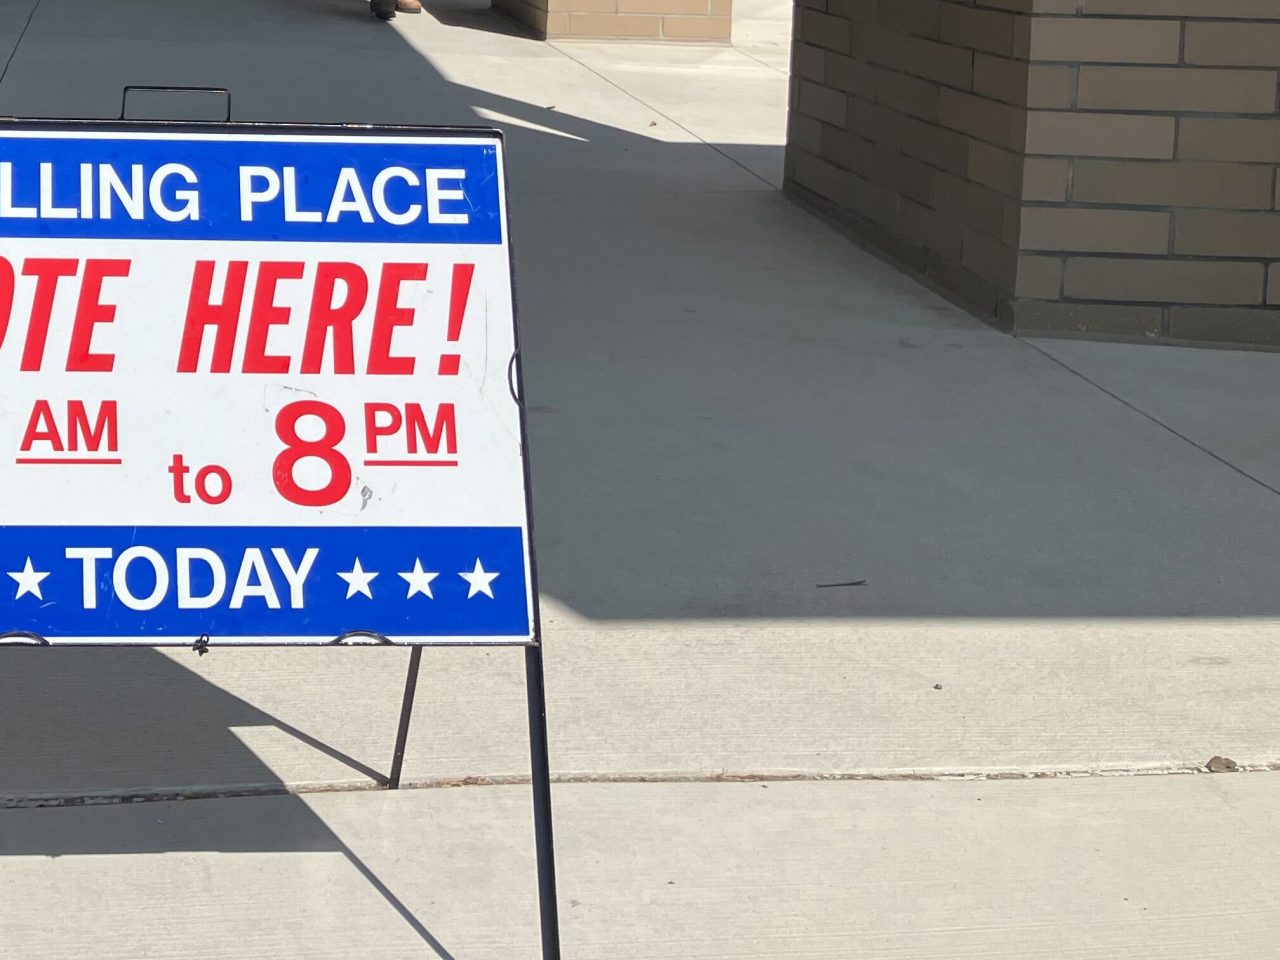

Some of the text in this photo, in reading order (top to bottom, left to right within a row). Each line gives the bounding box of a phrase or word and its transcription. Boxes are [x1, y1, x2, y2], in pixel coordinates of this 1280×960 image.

[239, 165, 469, 225] PLACE
[176, 259, 475, 376] HERE!
[20, 399, 119, 452] AM
[168, 453, 233, 505] to
[272, 399, 353, 508] 8
[363, 401, 458, 455] PM
[65, 545, 320, 611] TODAY
